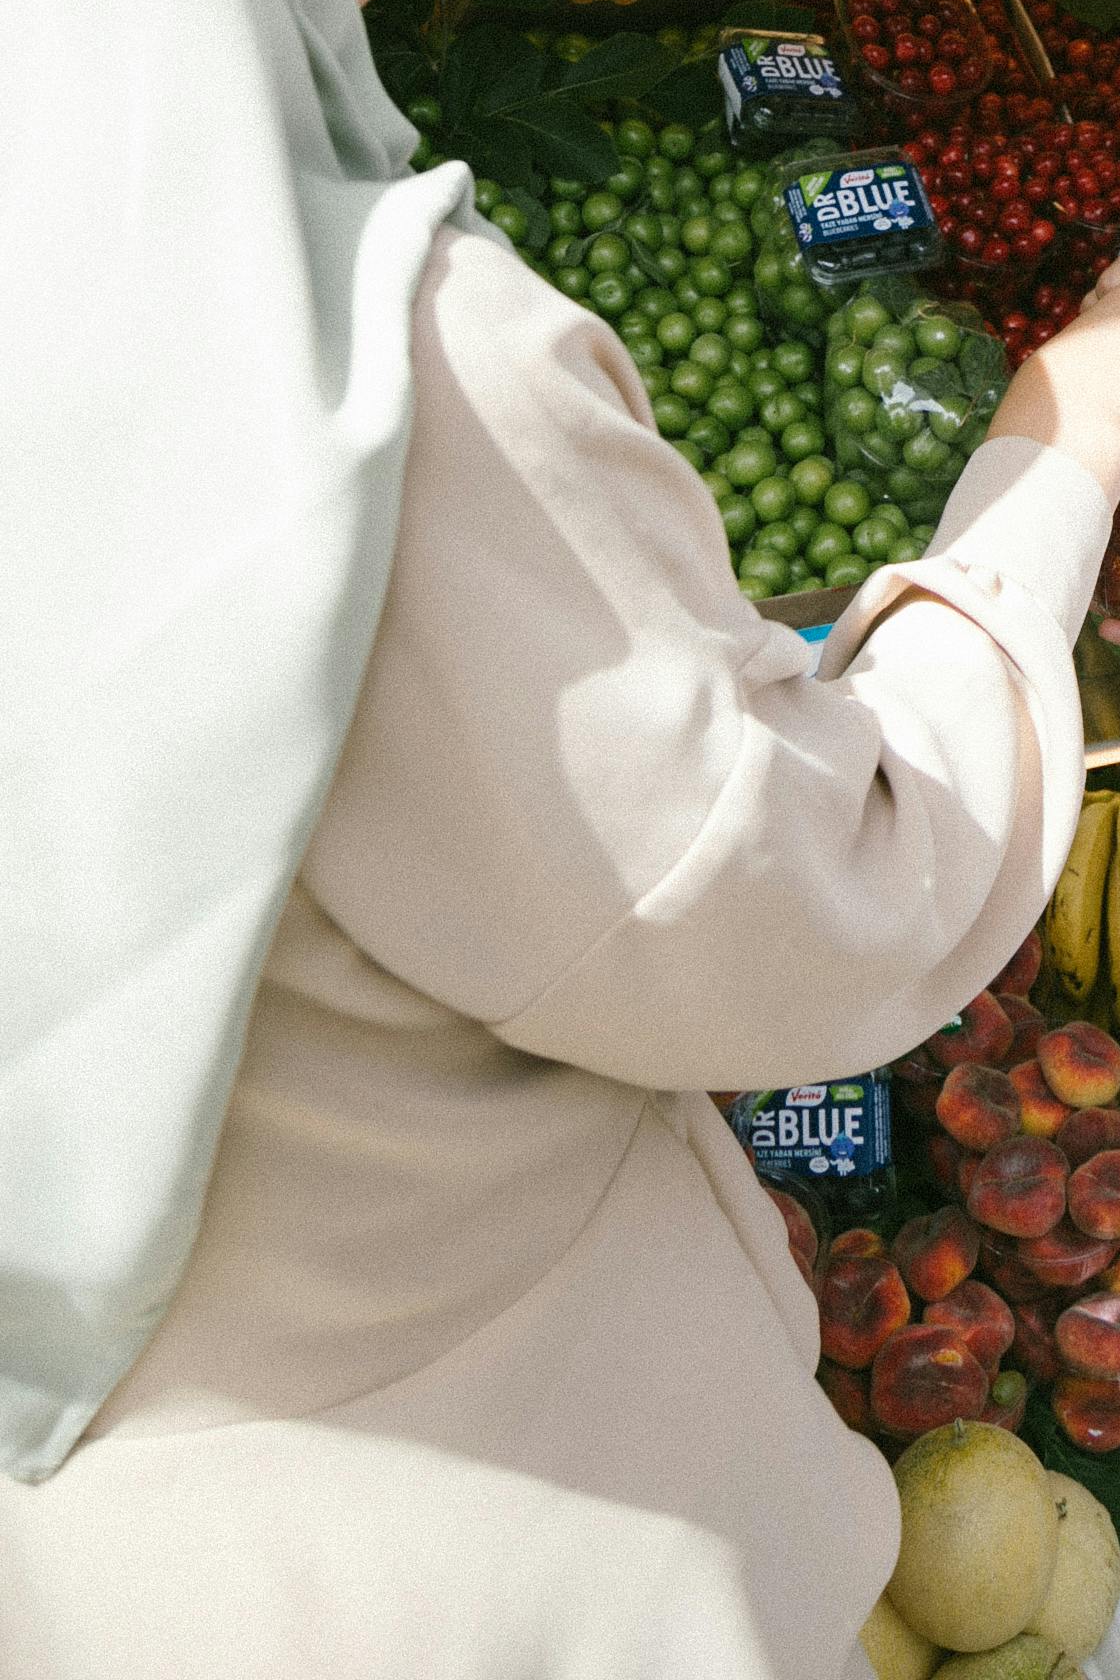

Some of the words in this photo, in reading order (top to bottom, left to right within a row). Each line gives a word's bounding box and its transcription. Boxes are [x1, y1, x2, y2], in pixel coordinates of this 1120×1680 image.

[757, 55, 781, 77] DR
[776, 56, 841, 81] BLUE
[813, 192, 840, 222] DR
[836, 180, 916, 217] BLUE
[752, 1110, 776, 1147] DR
[779, 1107, 864, 1147] BLUE
